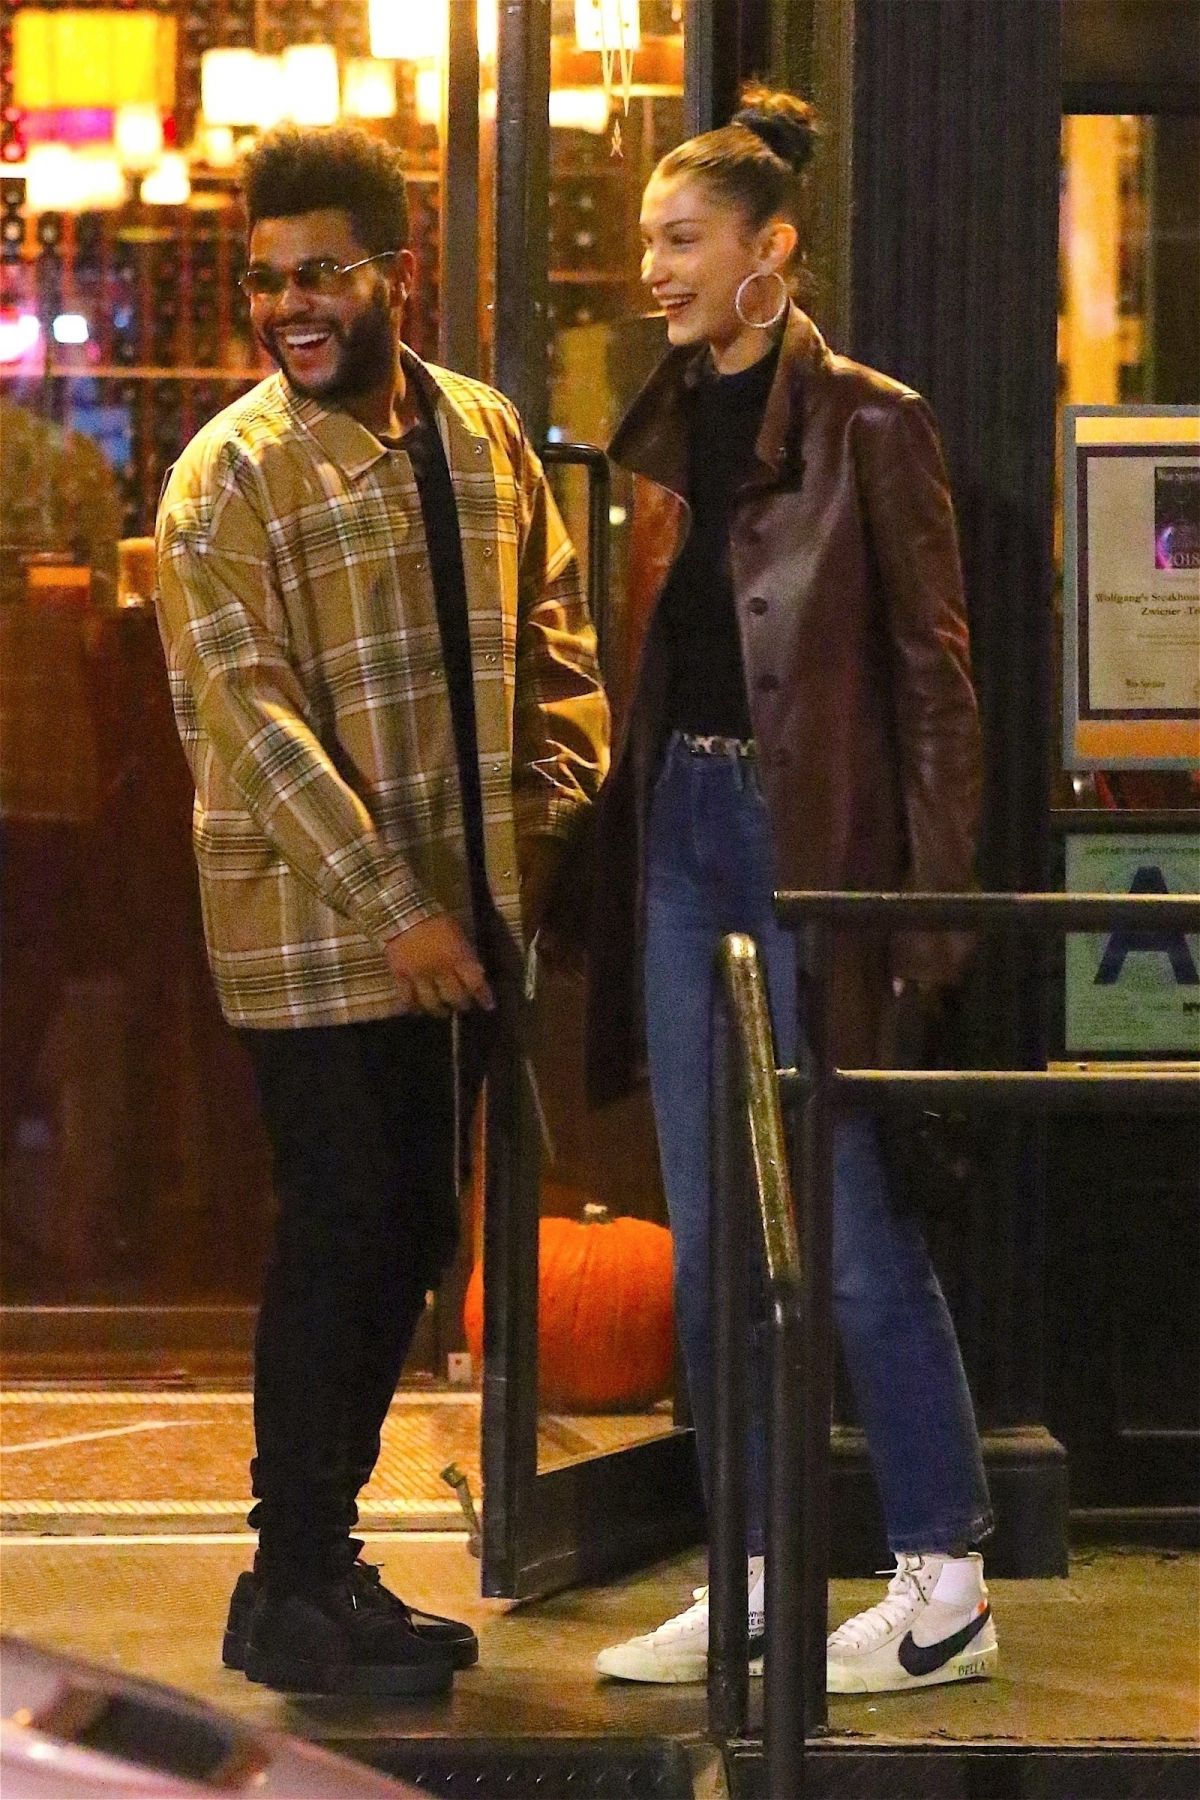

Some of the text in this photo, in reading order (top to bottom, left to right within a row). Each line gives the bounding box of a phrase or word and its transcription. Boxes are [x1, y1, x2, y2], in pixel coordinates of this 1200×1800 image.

[1095, 592, 1148, 604] Wolfgang's
[1141, 607, 1180, 616] Zwiener
[1093, 865, 1200, 985] A
